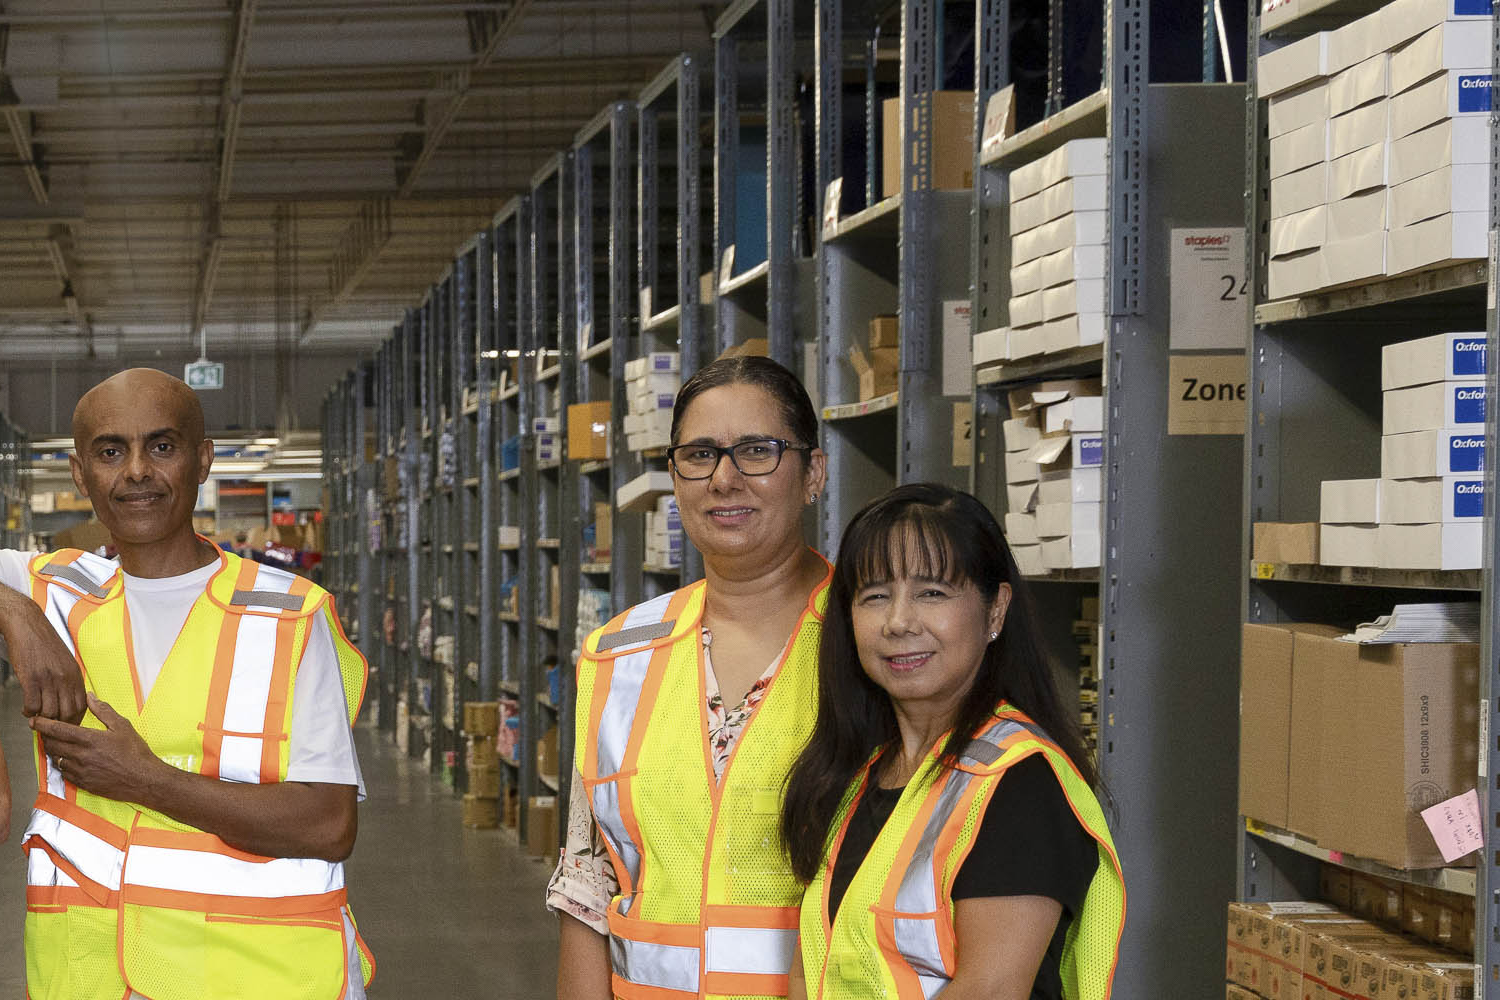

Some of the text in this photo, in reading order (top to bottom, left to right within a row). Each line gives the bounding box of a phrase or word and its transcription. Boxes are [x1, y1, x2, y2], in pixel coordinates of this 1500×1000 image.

[1182, 378, 1246, 401] Zone
[1457, 390, 1485, 400] Oxfor
[1457, 485, 1484, 494] Oxfor
